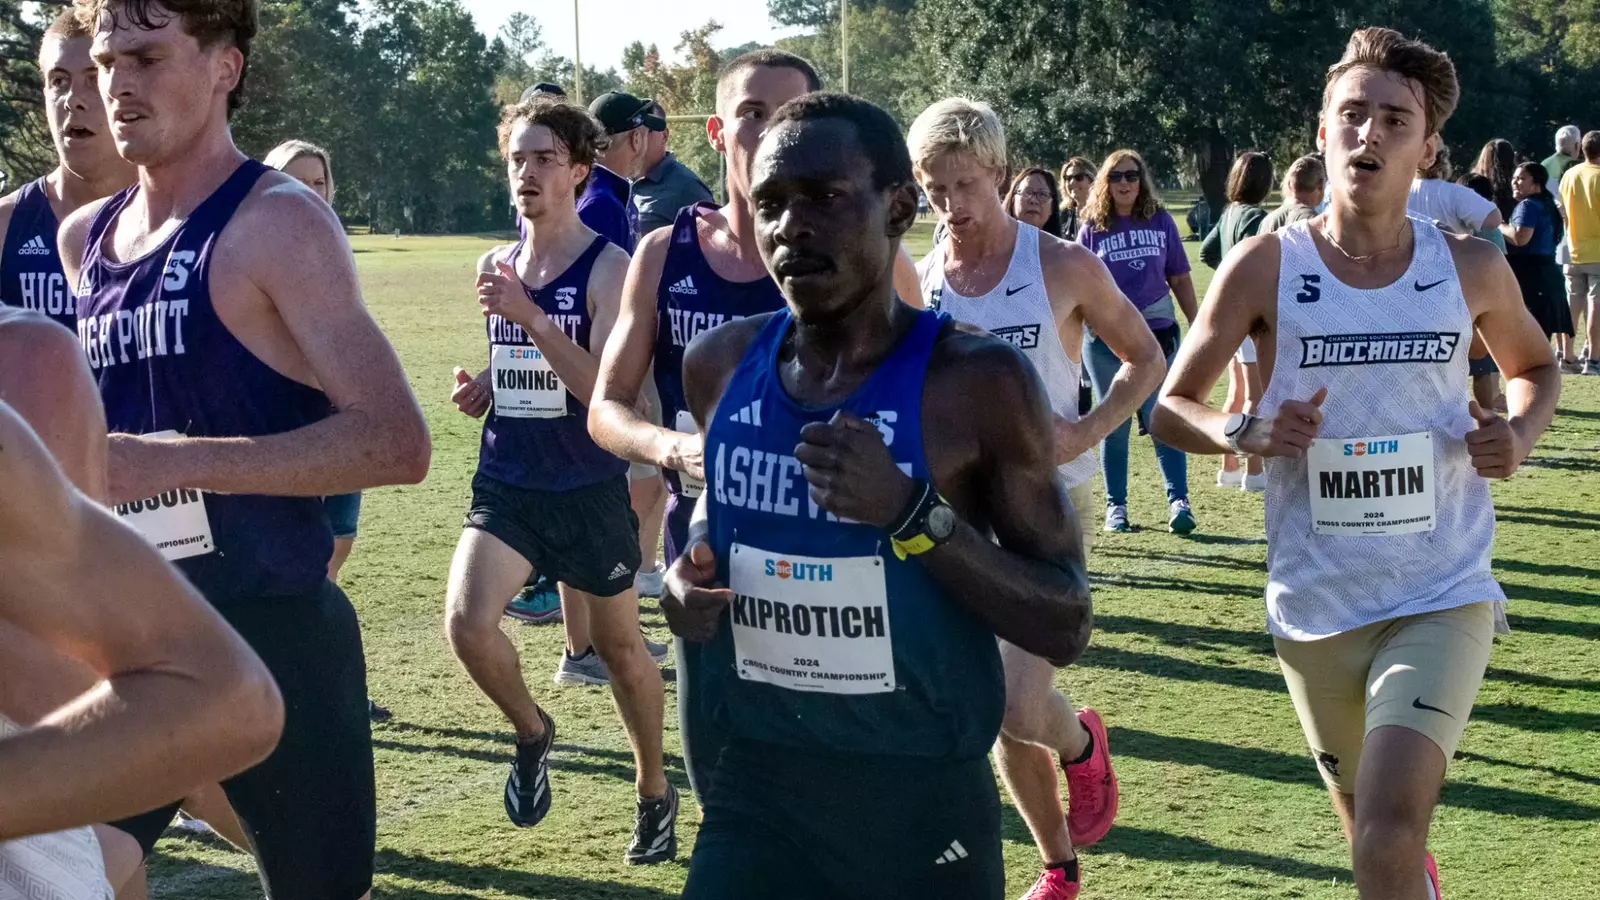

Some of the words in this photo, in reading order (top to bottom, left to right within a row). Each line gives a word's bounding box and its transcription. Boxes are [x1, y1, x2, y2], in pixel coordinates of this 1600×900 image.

[1098, 231, 1127, 254] HIGH
[1129, 229, 1167, 248] POINT
[1110, 246, 1160, 261] UNIVERSITY
[668, 285, 698, 295] adidas
[77, 313, 116, 369] IGH
[116, 299, 189, 364] POINT
[1301, 333, 1458, 367] BUCCANEERS
[497, 368, 558, 391] KONING
[1319, 465, 1424, 499] MARTIN
[1376, 515, 1431, 527] CHAMPIONSHIP
[156, 535, 205, 549] MPIONSHIP
[733, 593, 885, 638] KIPROTICH
[742, 658, 768, 671] CROSS
[769, 665, 808, 679] COUNTRY
[810, 672, 887, 681] CHAMPIONSHIP
[793, 657, 820, 667] 2024
